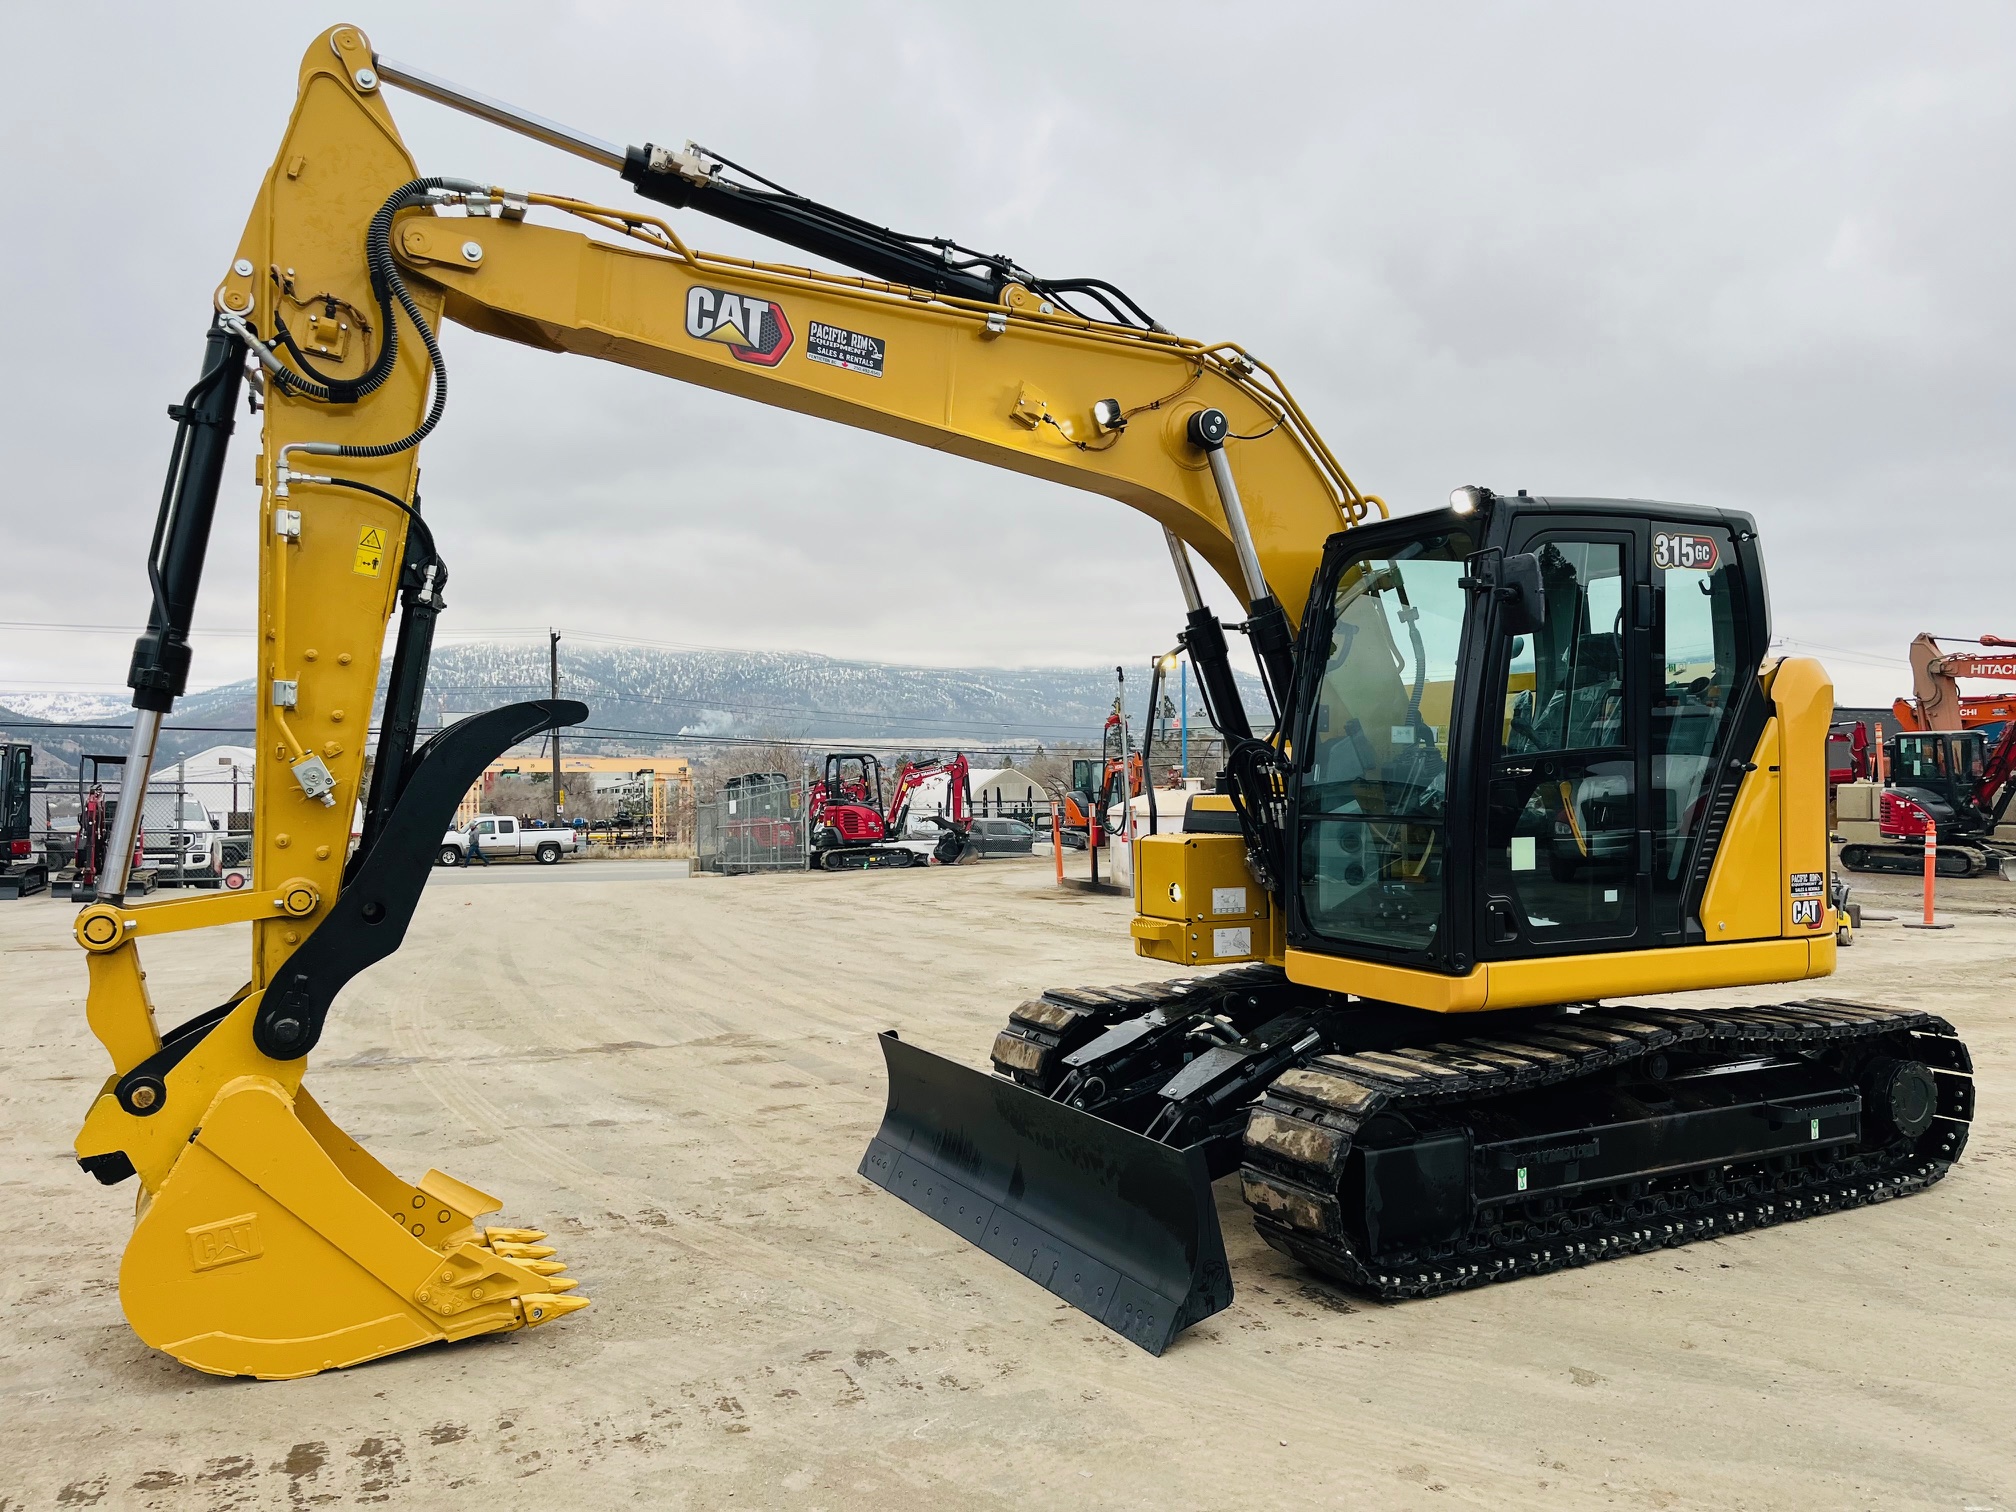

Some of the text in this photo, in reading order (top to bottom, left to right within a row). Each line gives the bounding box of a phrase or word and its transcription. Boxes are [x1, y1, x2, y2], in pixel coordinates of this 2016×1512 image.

[687, 286, 769, 348] CAT
[809, 336, 867, 356] EQUIPMENT
[811, 322, 868, 351] PACIFIC RIM
[817, 346, 874, 367] SALES & RENTALS
[1655, 534, 1710, 567] 315 GC
[1793, 900, 1818, 924] CAT
[196, 1222, 251, 1264] CAT
